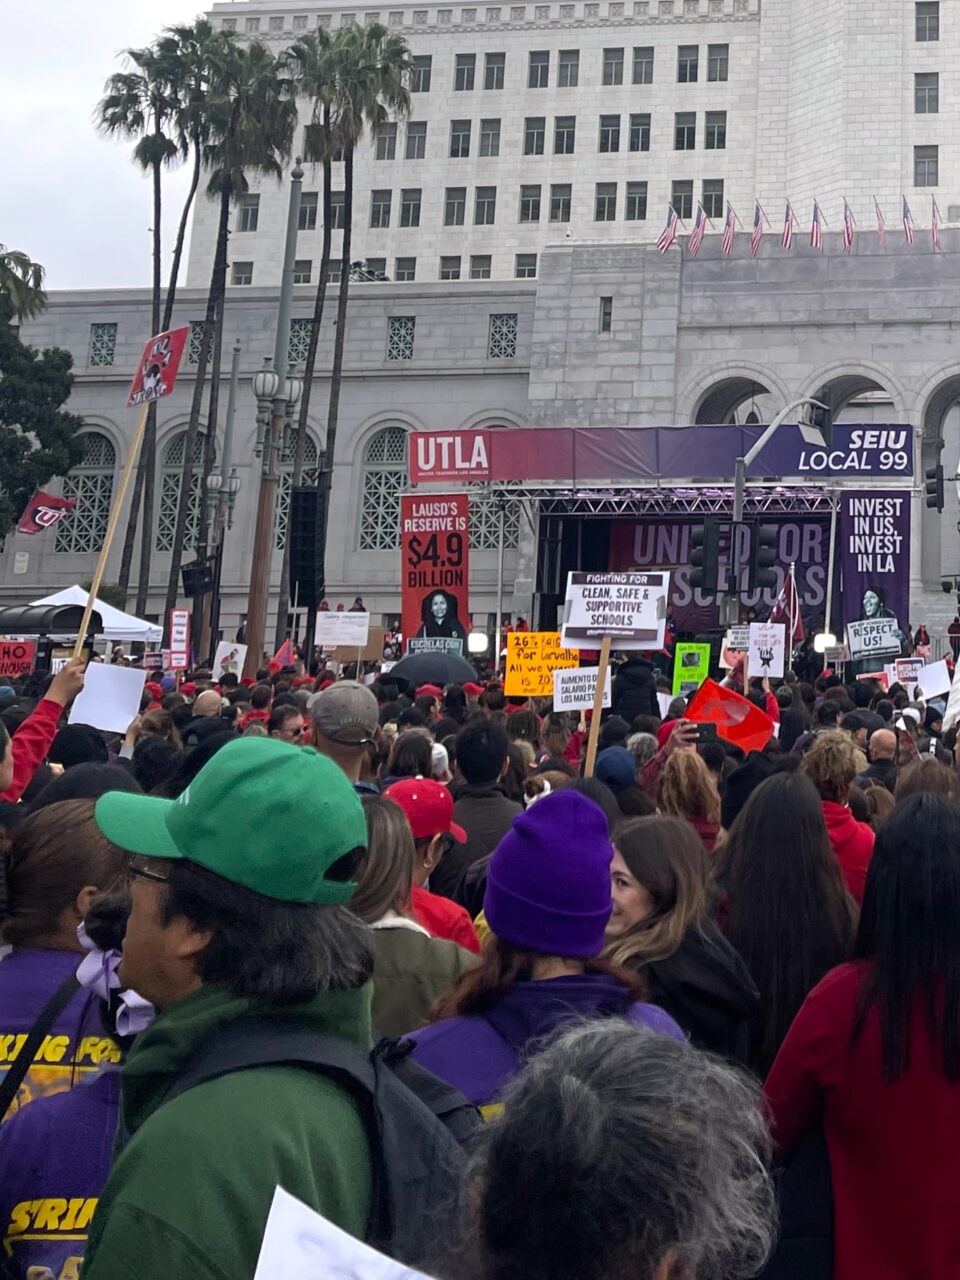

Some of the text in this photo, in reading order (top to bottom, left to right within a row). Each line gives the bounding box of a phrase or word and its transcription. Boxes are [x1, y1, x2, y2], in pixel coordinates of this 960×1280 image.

[849, 430, 907, 449] SEIU
[418, 436, 488, 470] UTLA
[798, 451, 908, 470] LOCAL 99
[412, 502, 458, 517] LAUSD'S
[849, 498, 903, 516] INVEST
[404, 517, 467, 532] RESERVE IS
[854, 517, 898, 537] IN US,
[408, 533, 463, 569] $4.9
[849, 535, 903, 554] INVEST
[857, 554, 895, 573] IN LA
[407, 569, 463, 588] BILLION
[586, 574, 648, 584] FIGHTING FOR
[582, 587, 649, 600] CLEAN, SAFE &
[585, 601, 643, 613] SUPPORTIVE
[590, 614, 634, 626] SCHOOLS
[514, 636, 538, 647] 26%
[863, 636, 882, 647] US!
[517, 648, 537, 660] for
[0, 662, 32, 674] NOUGH
[509, 663, 523, 673] All
[527, 665, 543, 673] we
[561, 675, 591, 685] AUMENTO
[561, 685, 587, 695] SALARIO
[561, 692, 608, 704] LOS MAESTS
